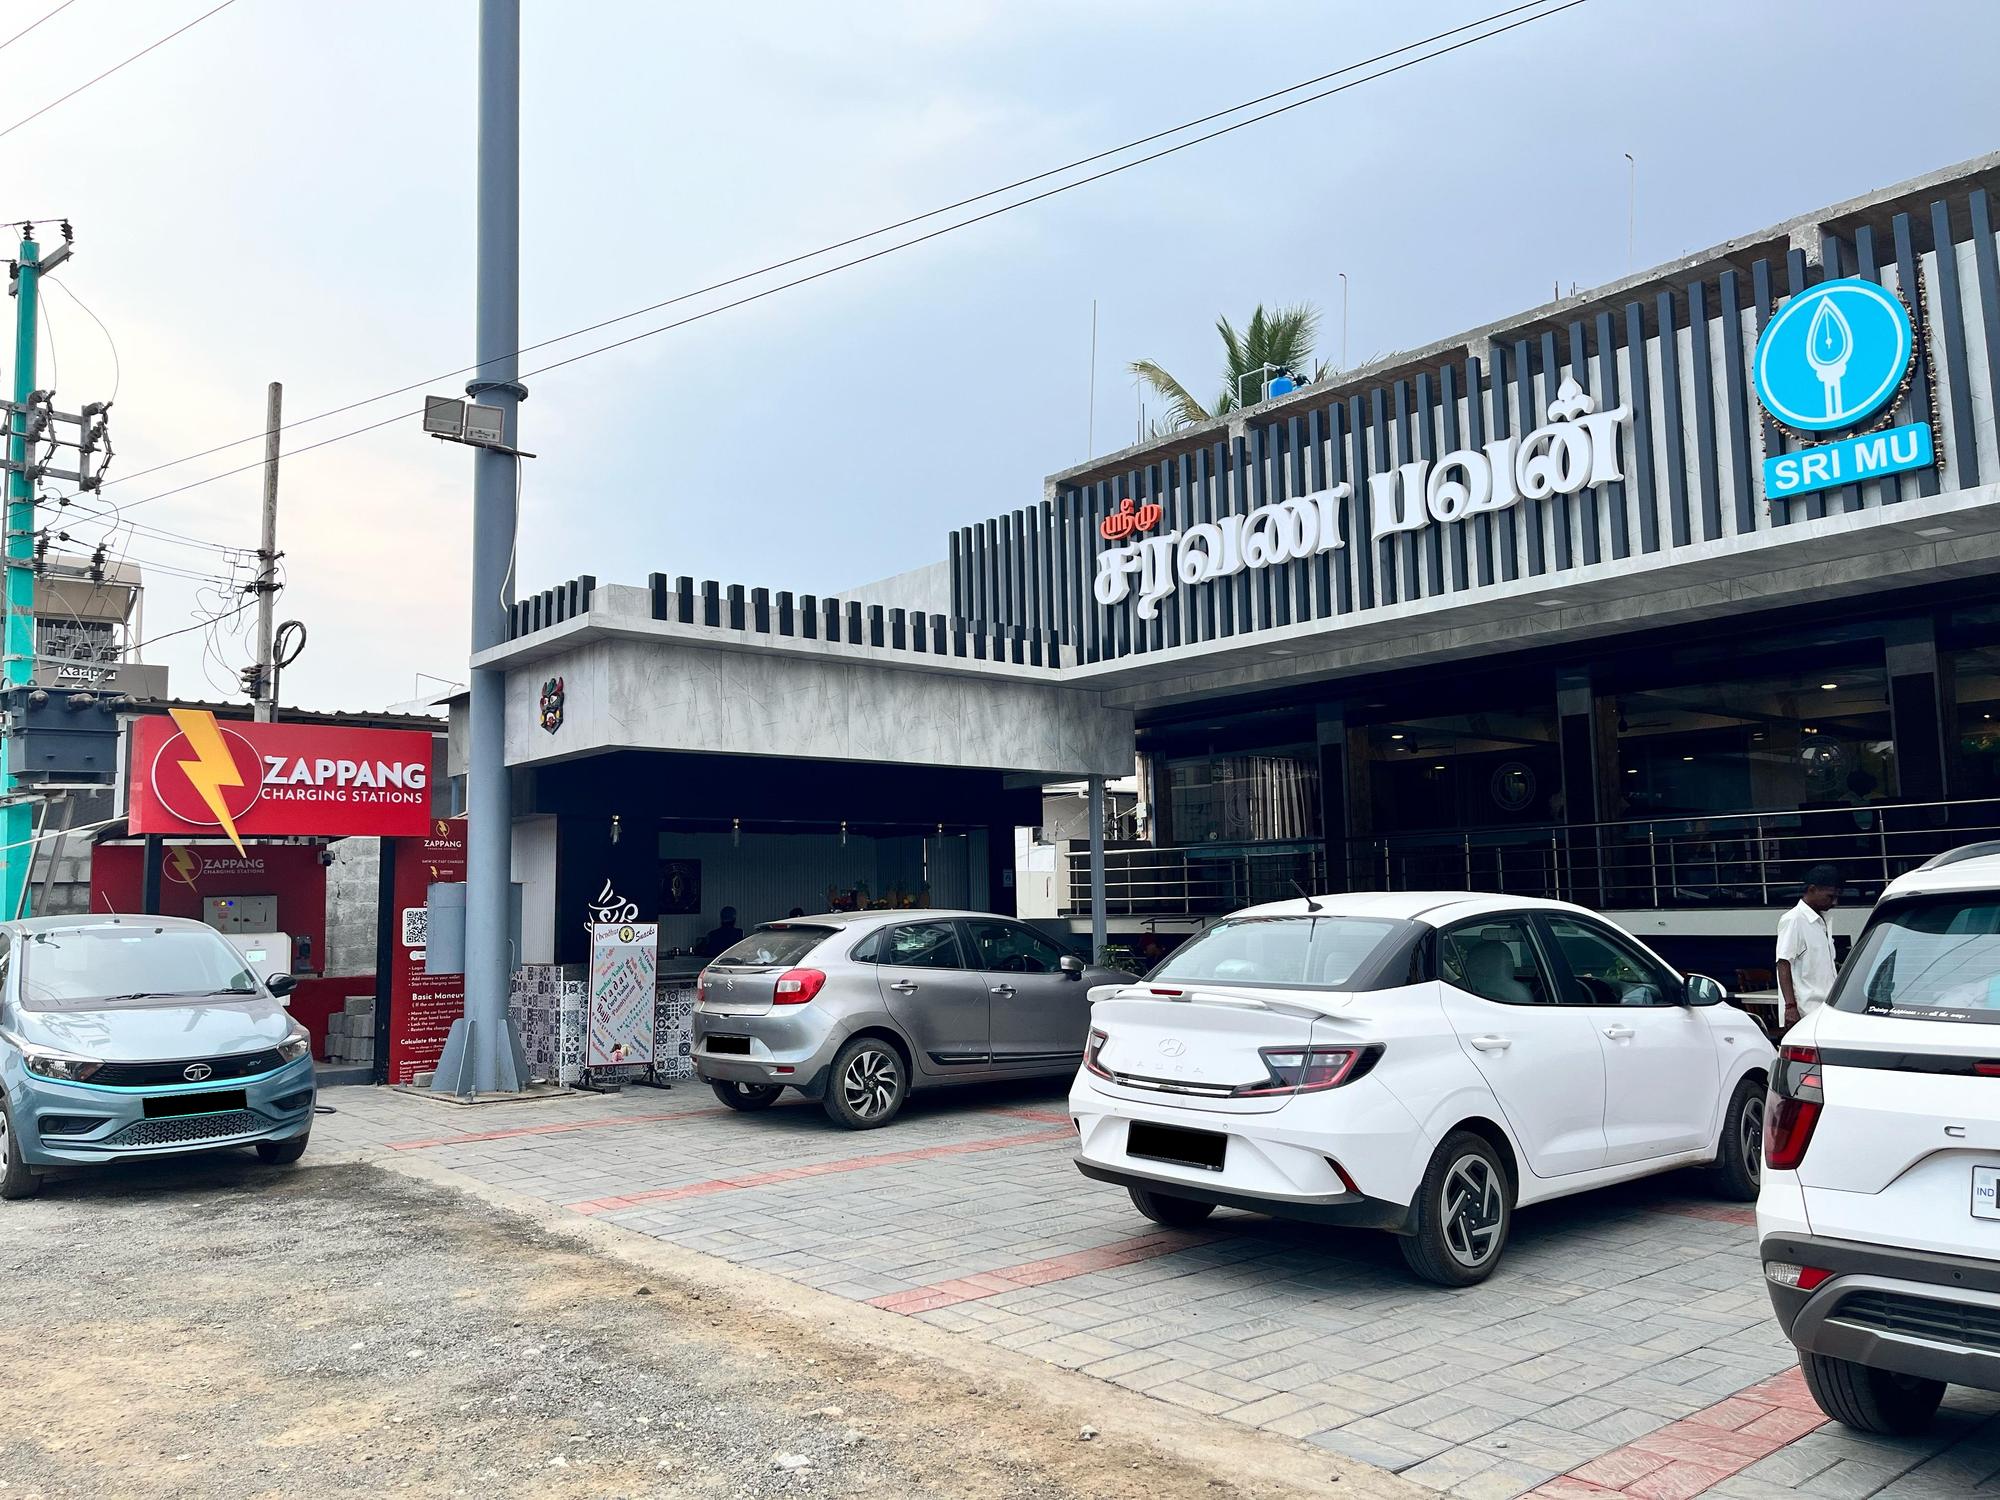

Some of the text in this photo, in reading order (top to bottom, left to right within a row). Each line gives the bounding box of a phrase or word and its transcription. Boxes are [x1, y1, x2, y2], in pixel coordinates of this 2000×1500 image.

[1774, 430, 1918, 490] SRI MU
[1093, 376, 1628, 620] சரவண பவன்
[58, 666, 116, 681] Kaap
[263, 755, 426, 789] ZAPPANG
[261, 788, 423, 804] CHARGING STATIONS
[423, 840, 462, 848] ZAPPANG
[204, 859, 265, 869] ZAPPANG
[635, 926, 655, 942] Snacks
[599, 969, 628, 1003] Vadai
[412, 992, 464, 1001] Basic Maneuv
[596, 1002, 611, 1024] Bajji
[1868, 1006, 1889, 1014] Driving
[1976, 1187, 1995, 1197] IND
